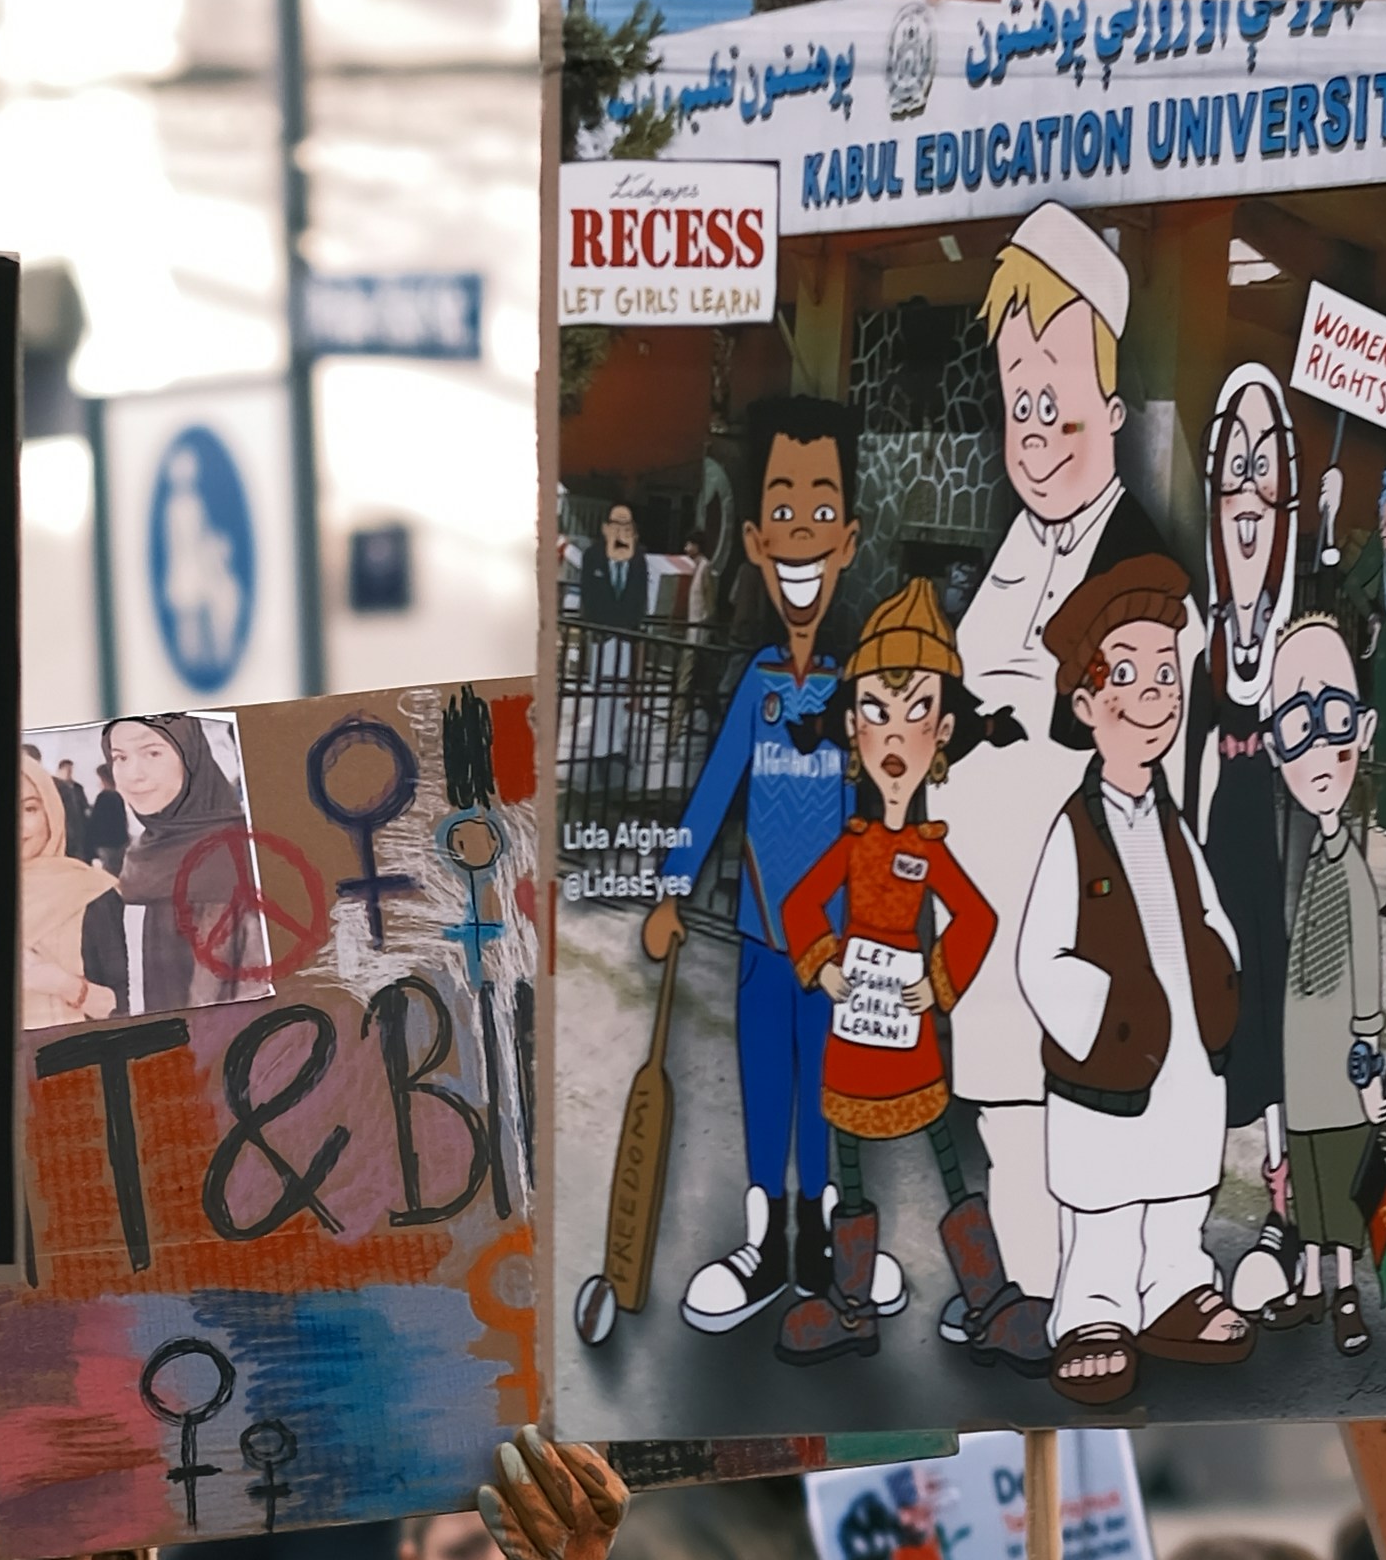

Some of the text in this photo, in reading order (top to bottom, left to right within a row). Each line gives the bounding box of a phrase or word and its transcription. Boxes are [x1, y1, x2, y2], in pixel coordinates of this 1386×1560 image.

[802, 140, 902, 209] KABUL
[915, 106, 1133, 193] EDUCATION
[570, 208, 765, 268] RECESS
[563, 286, 761, 318] LET GIRLS LEARN
[564, 820, 693, 856] Lida Afghan
[563, 868, 693, 903] @LidasEyes
[856, 944, 897, 967] LET
[851, 993, 901, 1019] GIRLS
